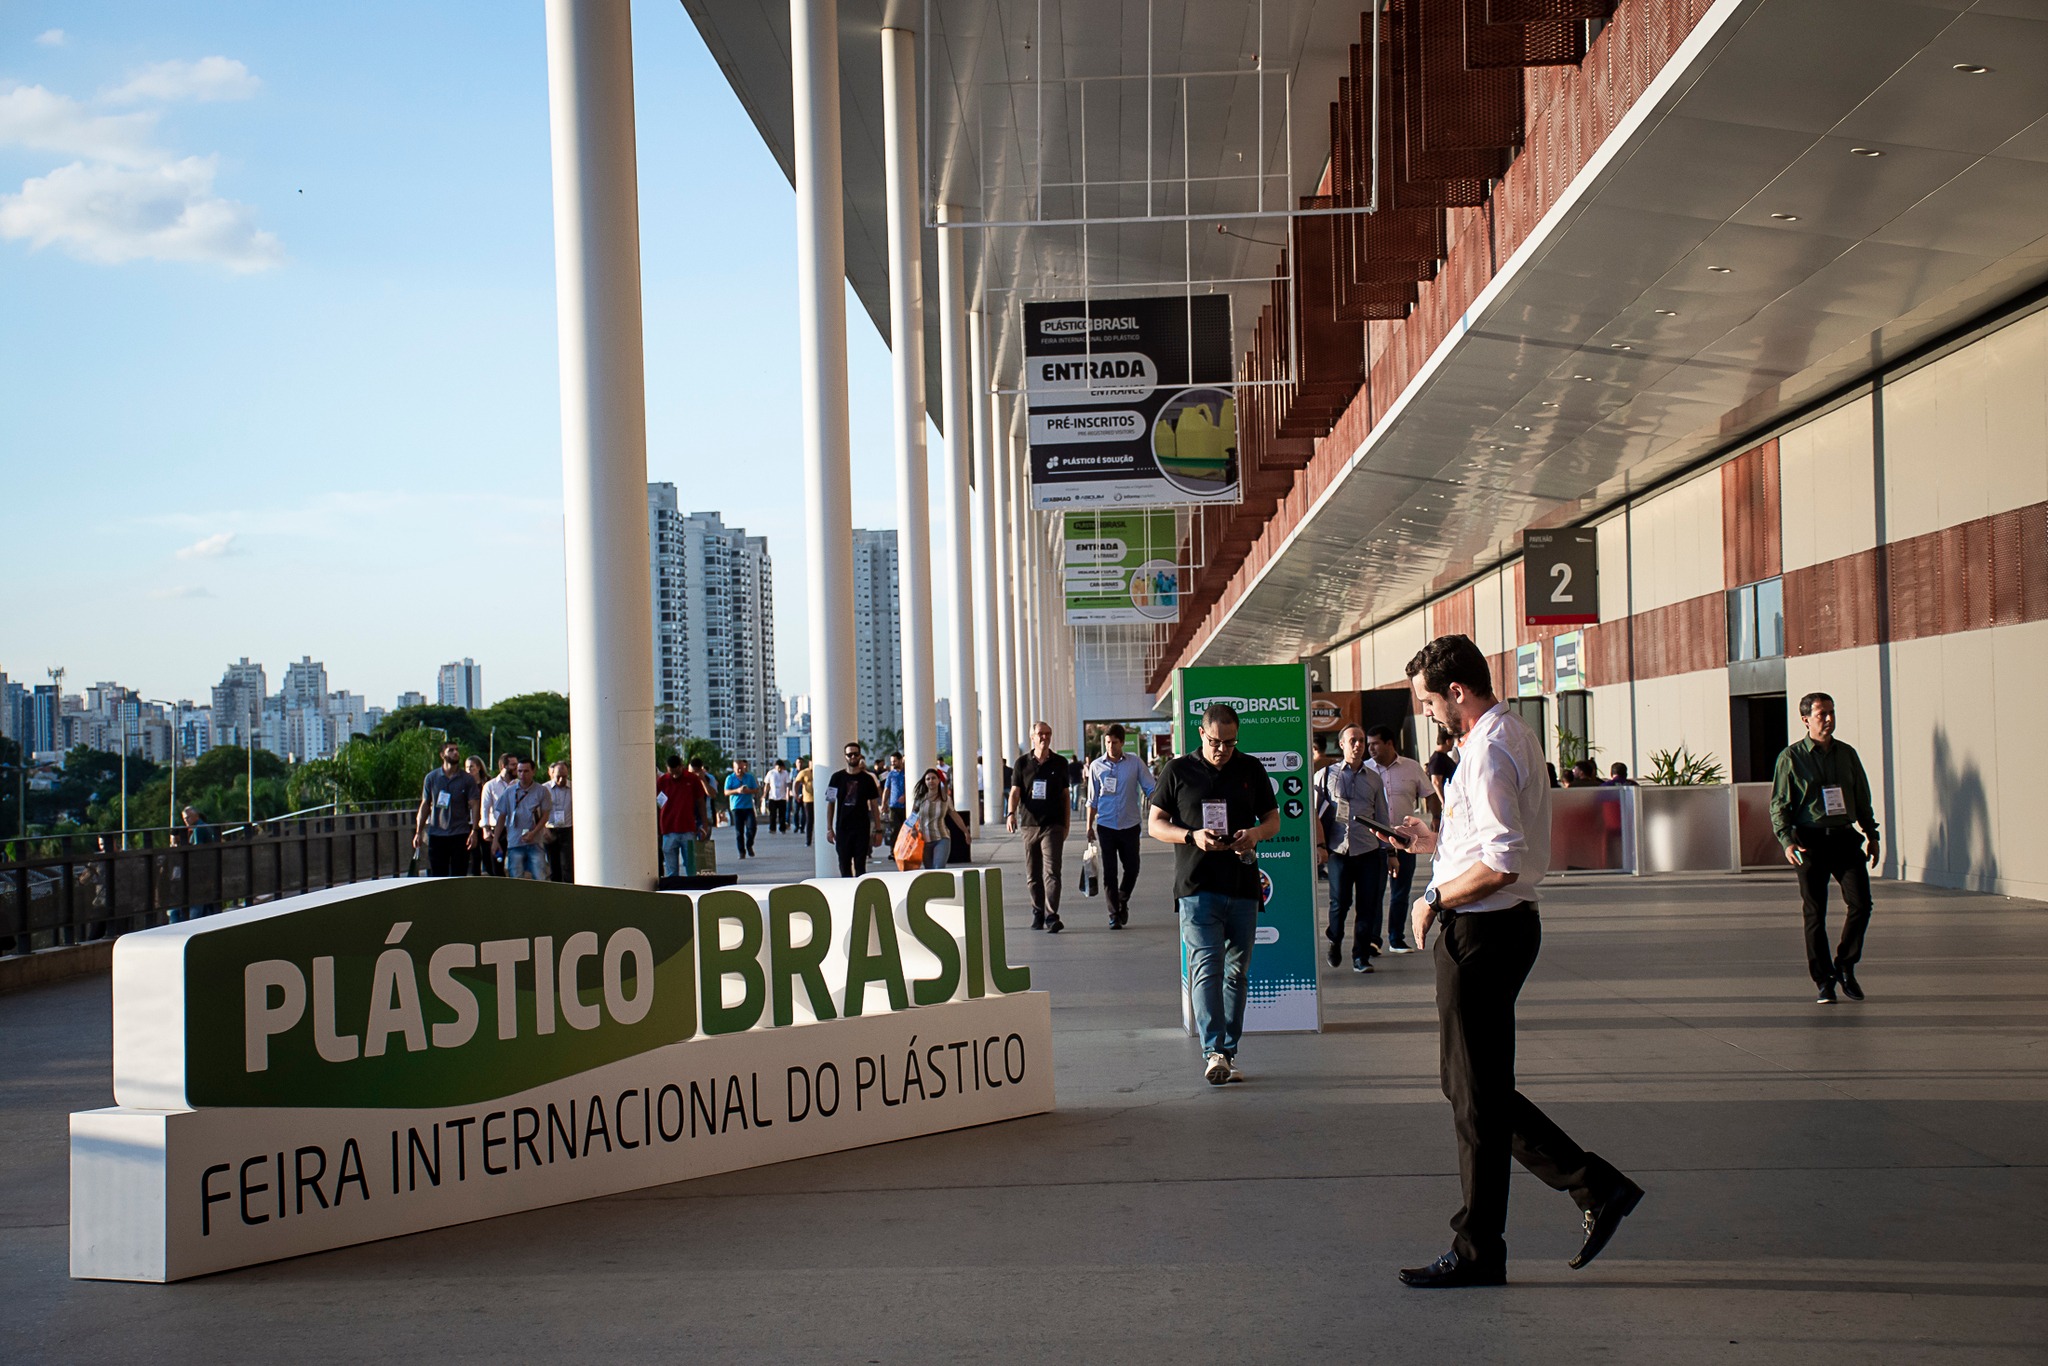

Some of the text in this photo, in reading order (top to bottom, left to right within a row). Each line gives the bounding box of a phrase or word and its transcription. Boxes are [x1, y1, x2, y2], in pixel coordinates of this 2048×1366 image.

[1094, 317, 1139, 330] BRASIL
[1113, 333, 1140, 341] PLÁSTICO
[1042, 360, 1146, 382] ENTRADA
[1047, 415, 1135, 430] PRÉ-INSCRITOS
[1062, 456, 1096, 466] PLÁSTICO
[1102, 453, 1134, 464] SOLUÇÃO
[1550, 563, 1573, 603] 2
[1249, 697, 1300, 712] BRASIL
[1271, 715, 1300, 724] PLÁSTICO
[1261, 850, 1291, 859] SOLUÇÃO
[244, 868, 1031, 1073] PLÁSTICO BRASIL
[201, 1034, 1028, 1237] FEIRA INTERNACIONAL DO PLÁSTICO
